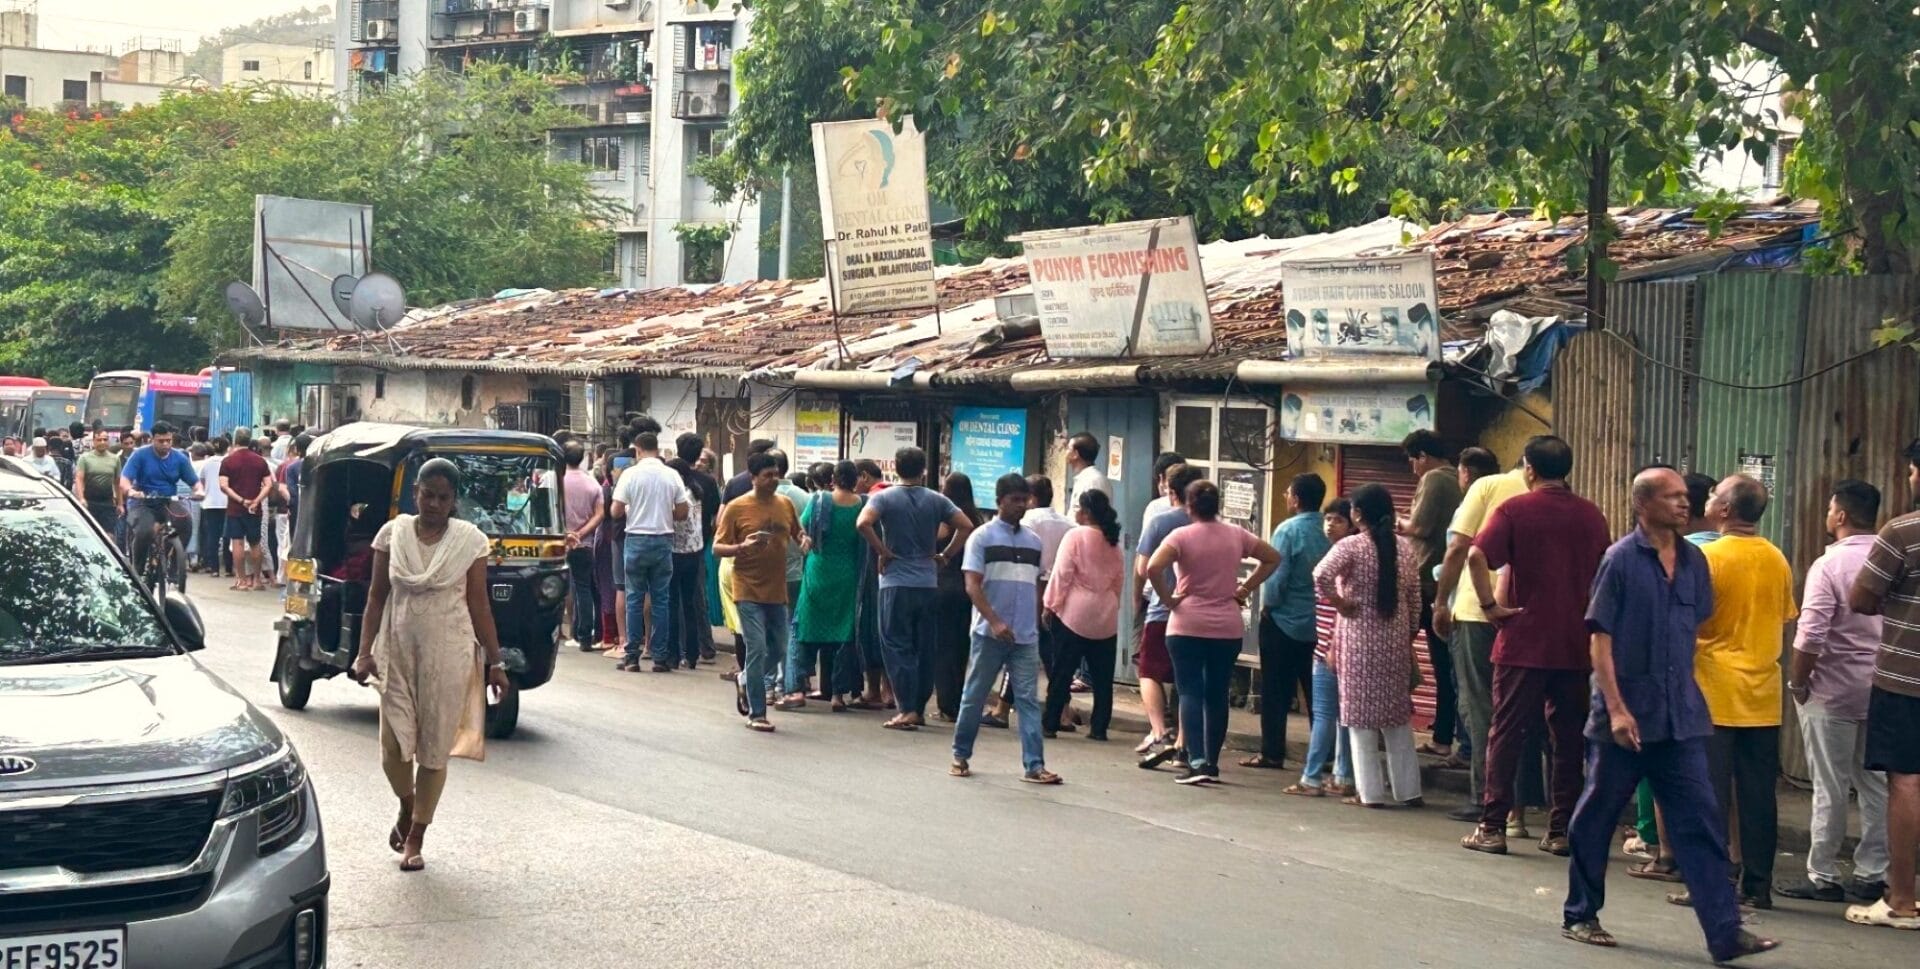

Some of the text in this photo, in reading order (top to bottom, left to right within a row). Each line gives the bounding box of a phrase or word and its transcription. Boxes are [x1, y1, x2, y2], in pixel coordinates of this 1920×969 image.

[838, 231, 854, 241] Dr.
[856, 226, 888, 239] Rahul
[905, 221, 928, 233] Patil
[846, 253, 864, 266] ORAL
[1033, 246, 1189, 282] PUNYA FURNISHING
[1346, 283, 1386, 300] CUTTING
[1389, 281, 1426, 299] SALOON
[970, 421, 995, 433] DENTAL
[997, 423, 1021, 435] CLINIC
